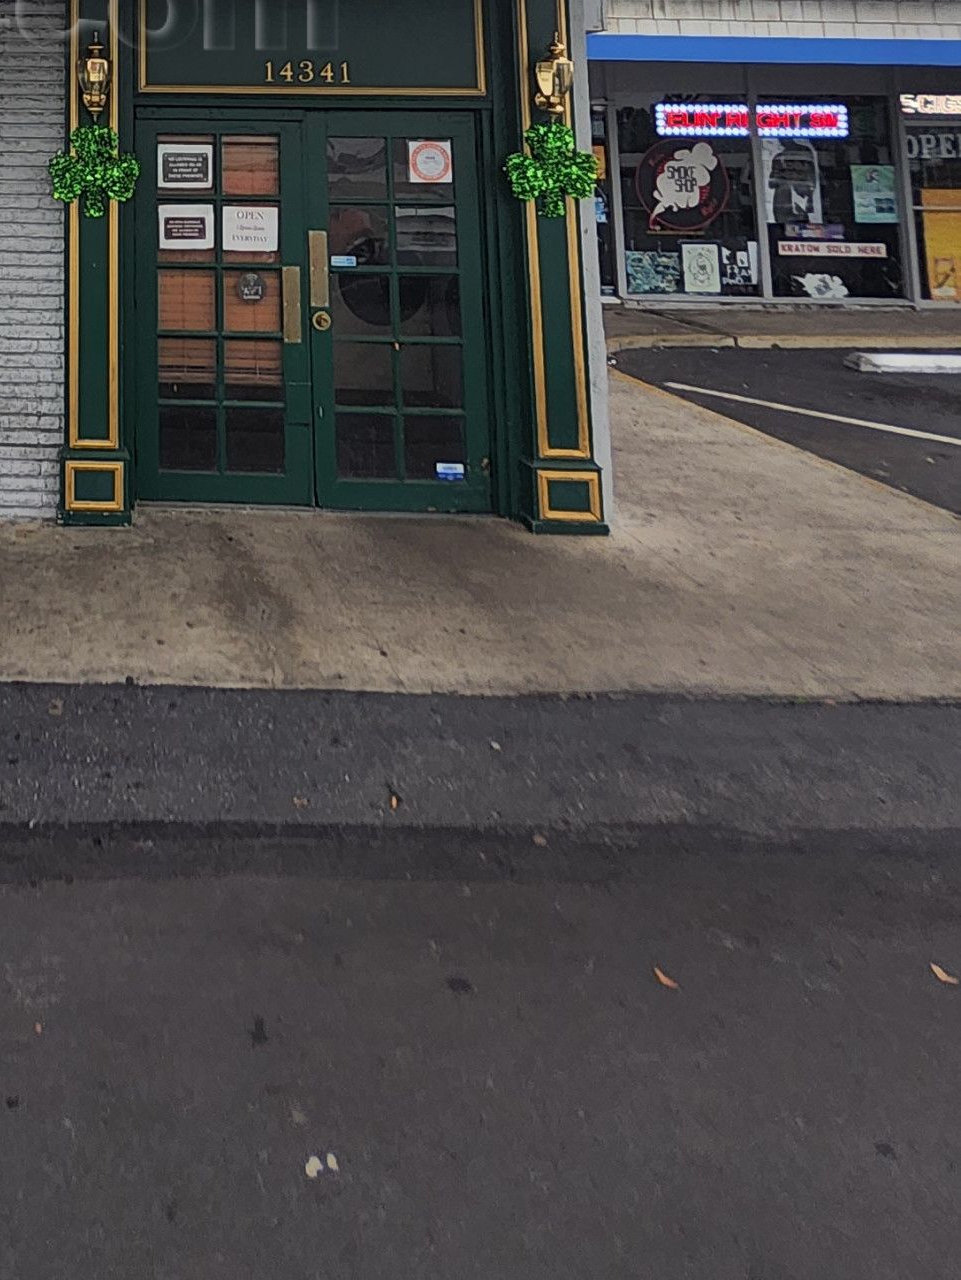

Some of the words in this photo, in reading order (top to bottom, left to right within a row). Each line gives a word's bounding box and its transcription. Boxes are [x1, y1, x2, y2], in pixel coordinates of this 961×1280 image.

[264, 60, 351, 84] 14341
[903, 133, 961, 159] OPE
[666, 166, 696, 180] SMOKE
[675, 179, 698, 193] SHOP
[236, 210, 264, 220] OPEN
[826, 244, 851, 254] SOLD
[857, 245, 883, 255] HERE
